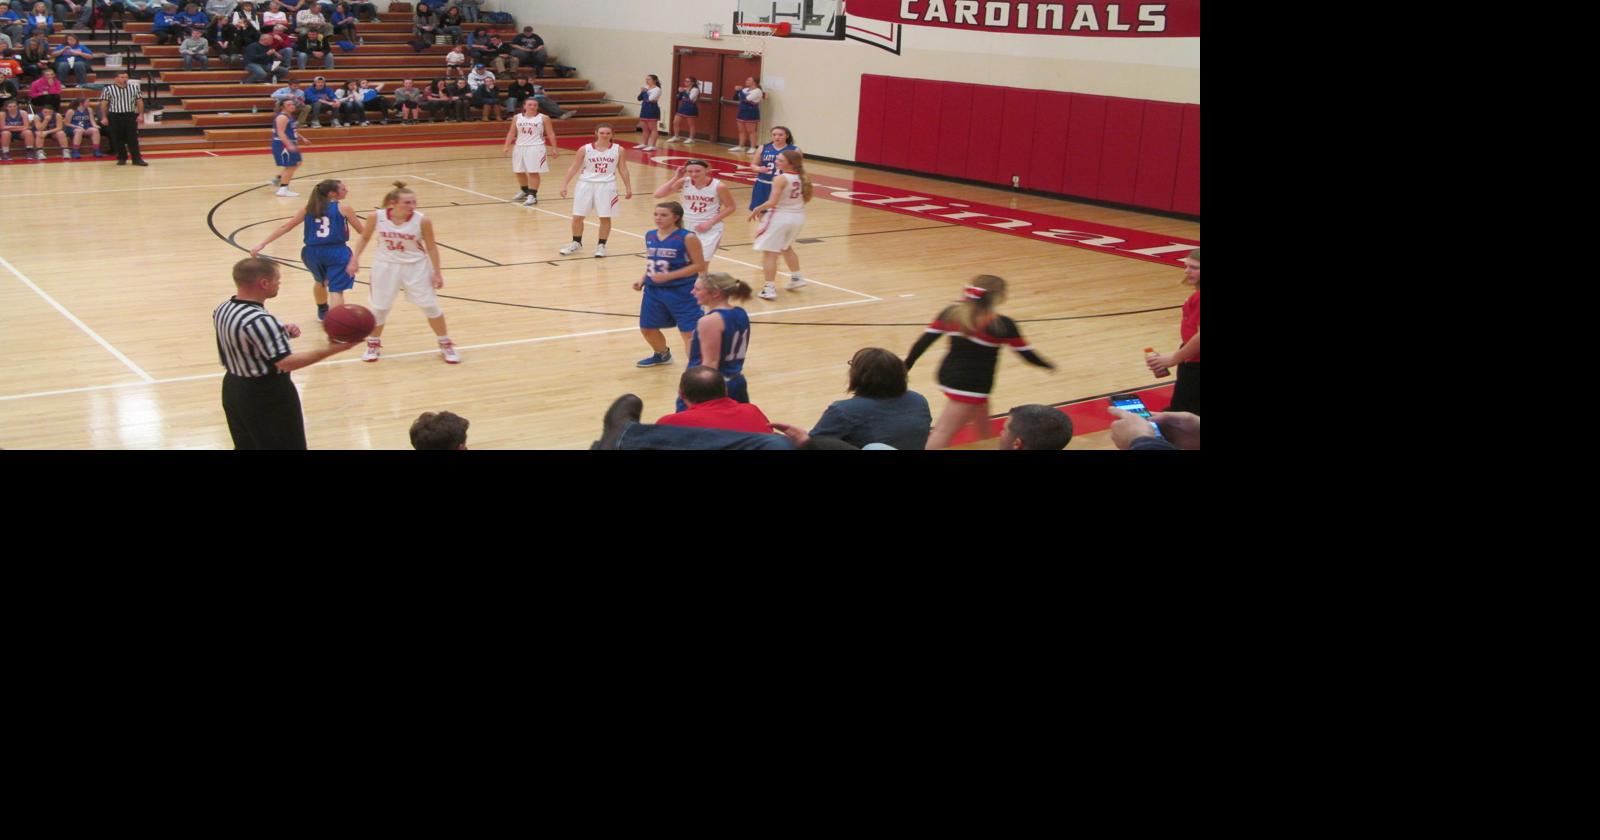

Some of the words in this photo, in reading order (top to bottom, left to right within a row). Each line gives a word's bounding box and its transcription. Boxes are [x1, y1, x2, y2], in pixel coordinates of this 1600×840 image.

[899, 0, 1167, 32] CARDINALS
[521, 127, 533, 135] 44
[689, 201, 707, 213] 42
[314, 216, 331, 238] 3
[384, 239, 405, 252] 34
